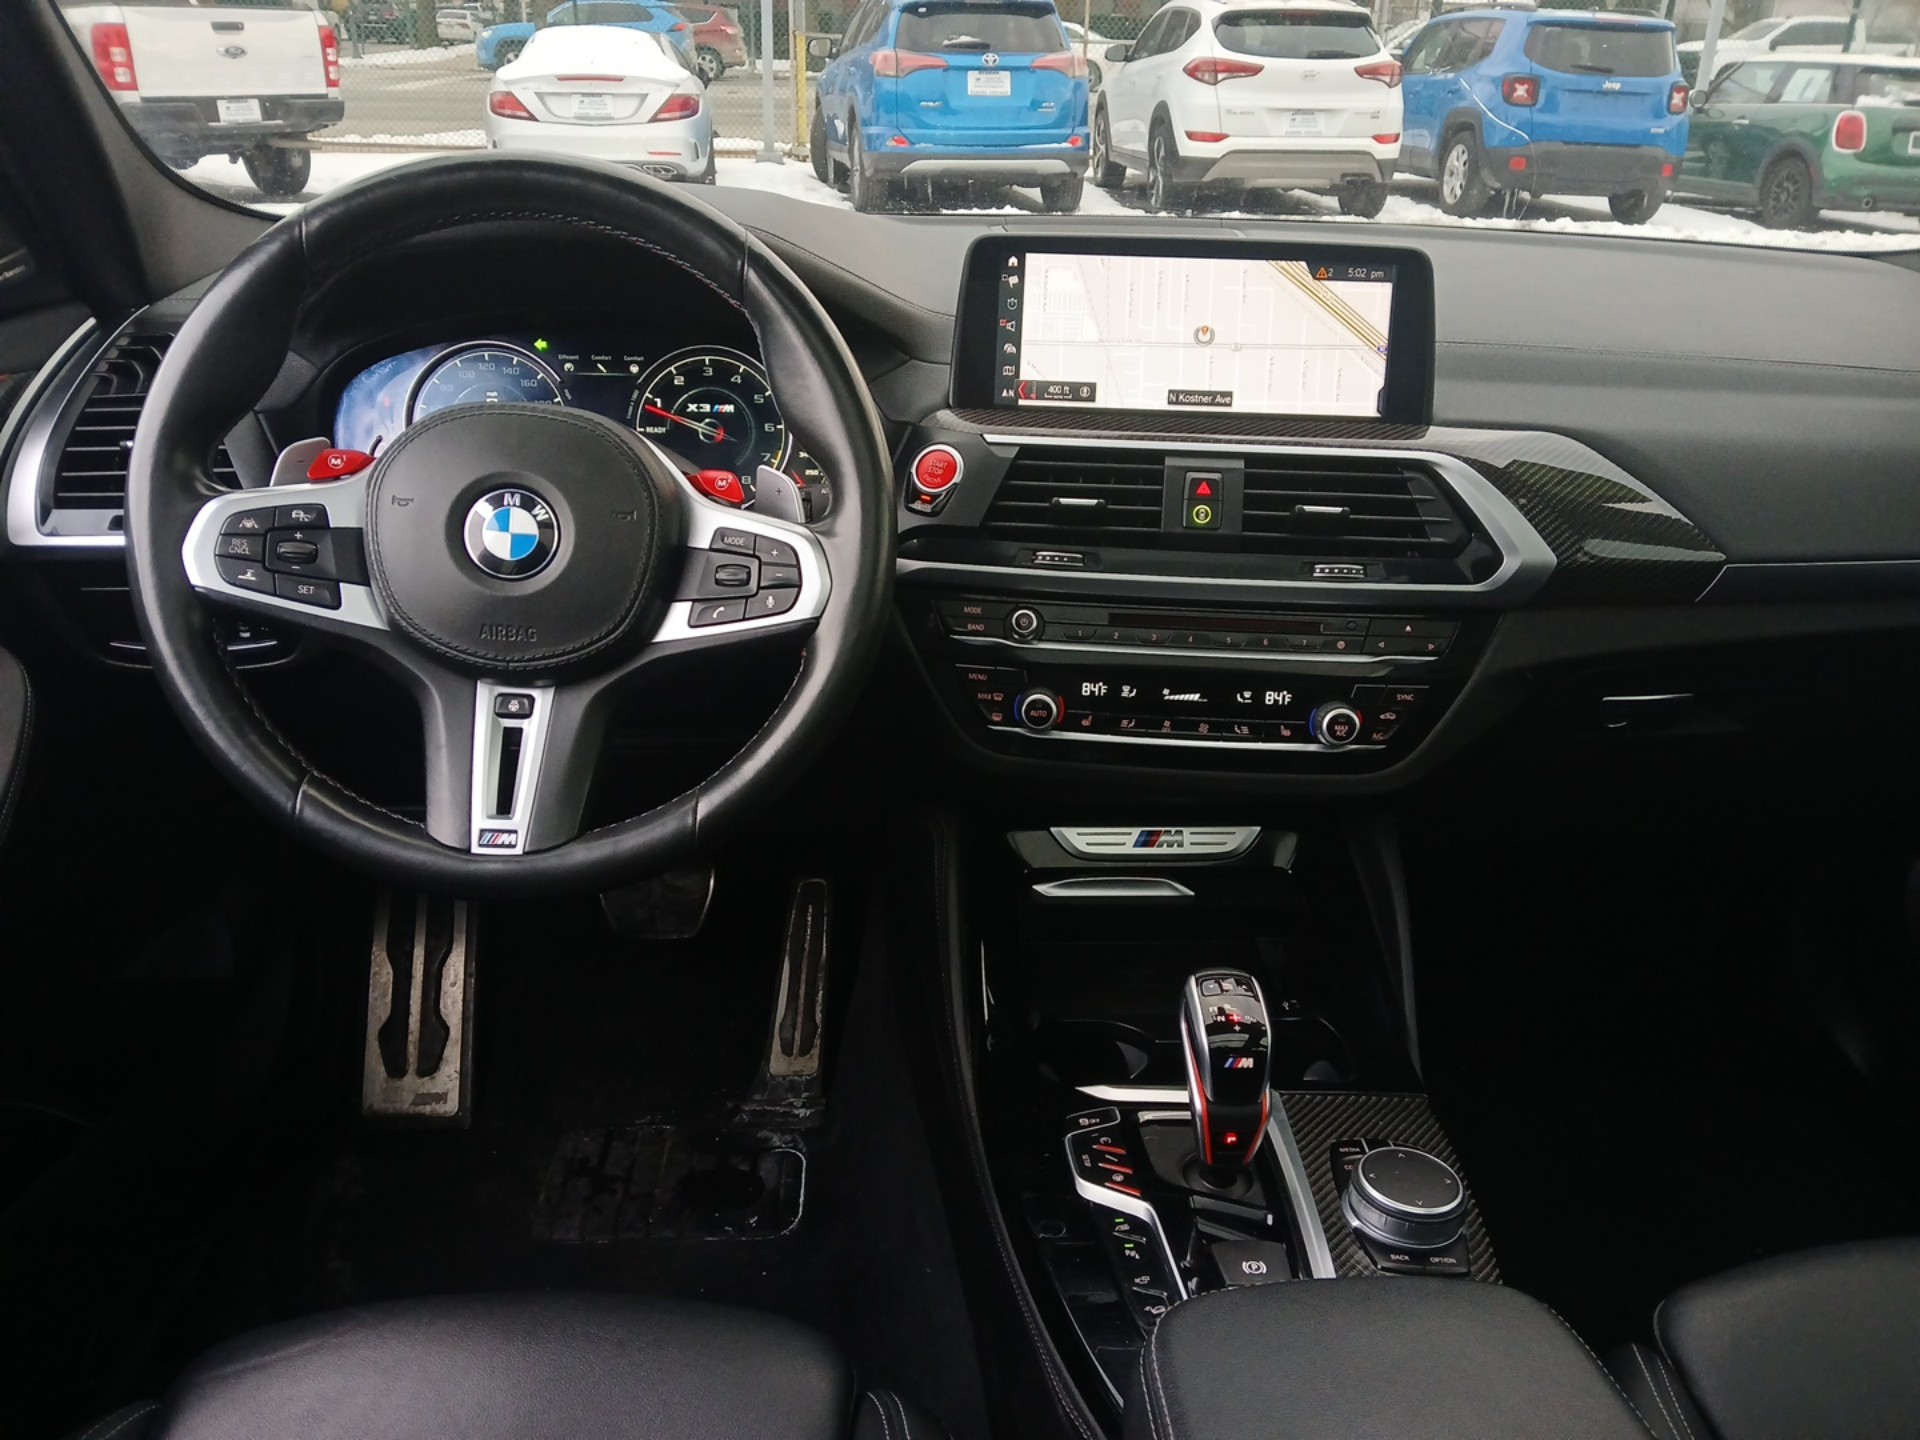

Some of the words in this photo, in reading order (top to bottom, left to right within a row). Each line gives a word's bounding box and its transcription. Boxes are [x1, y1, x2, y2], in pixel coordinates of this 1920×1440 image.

[1602, 80, 1621, 90] Jeep
[1327, 268, 1334, 277] 2
[1347, 268, 1368, 278] 5:02
[1370, 270, 1384, 278] pm
[478, 363, 496, 371] 120
[503, 367, 520, 375] 140
[702, 367, 713, 376] 3
[458, 370, 475, 378] 100
[520, 379, 537, 387] 160
[674, 376, 685, 385] 2
[730, 375, 742, 384] 4
[1047, 385, 1061, 394] 400
[1063, 385, 1070, 394] ft
[654, 398, 662, 408] 1
[754, 394, 764, 404] 5
[1168, 393, 1176, 402] N
[1178, 393, 1213, 404] Kostner
[1214, 394, 1231, 404] Ave
[686, 403, 711, 412] X3
[764, 423, 775, 432] 6
[760, 452, 771, 462] 7
[930, 460, 948, 469] START
[928, 467, 944, 475] STOP
[741, 475, 752, 484] 8
[231, 538, 248, 547] RES
[723, 536, 745, 546] MODE
[228, 545, 251, 555] CNCL
[297, 585, 315, 595] SET
[963, 606, 982, 614] MODE
[480, 623, 537, 642] AIRBAG
[968, 673, 987, 681] MENU
[1372, 732, 1383, 740] A/C
